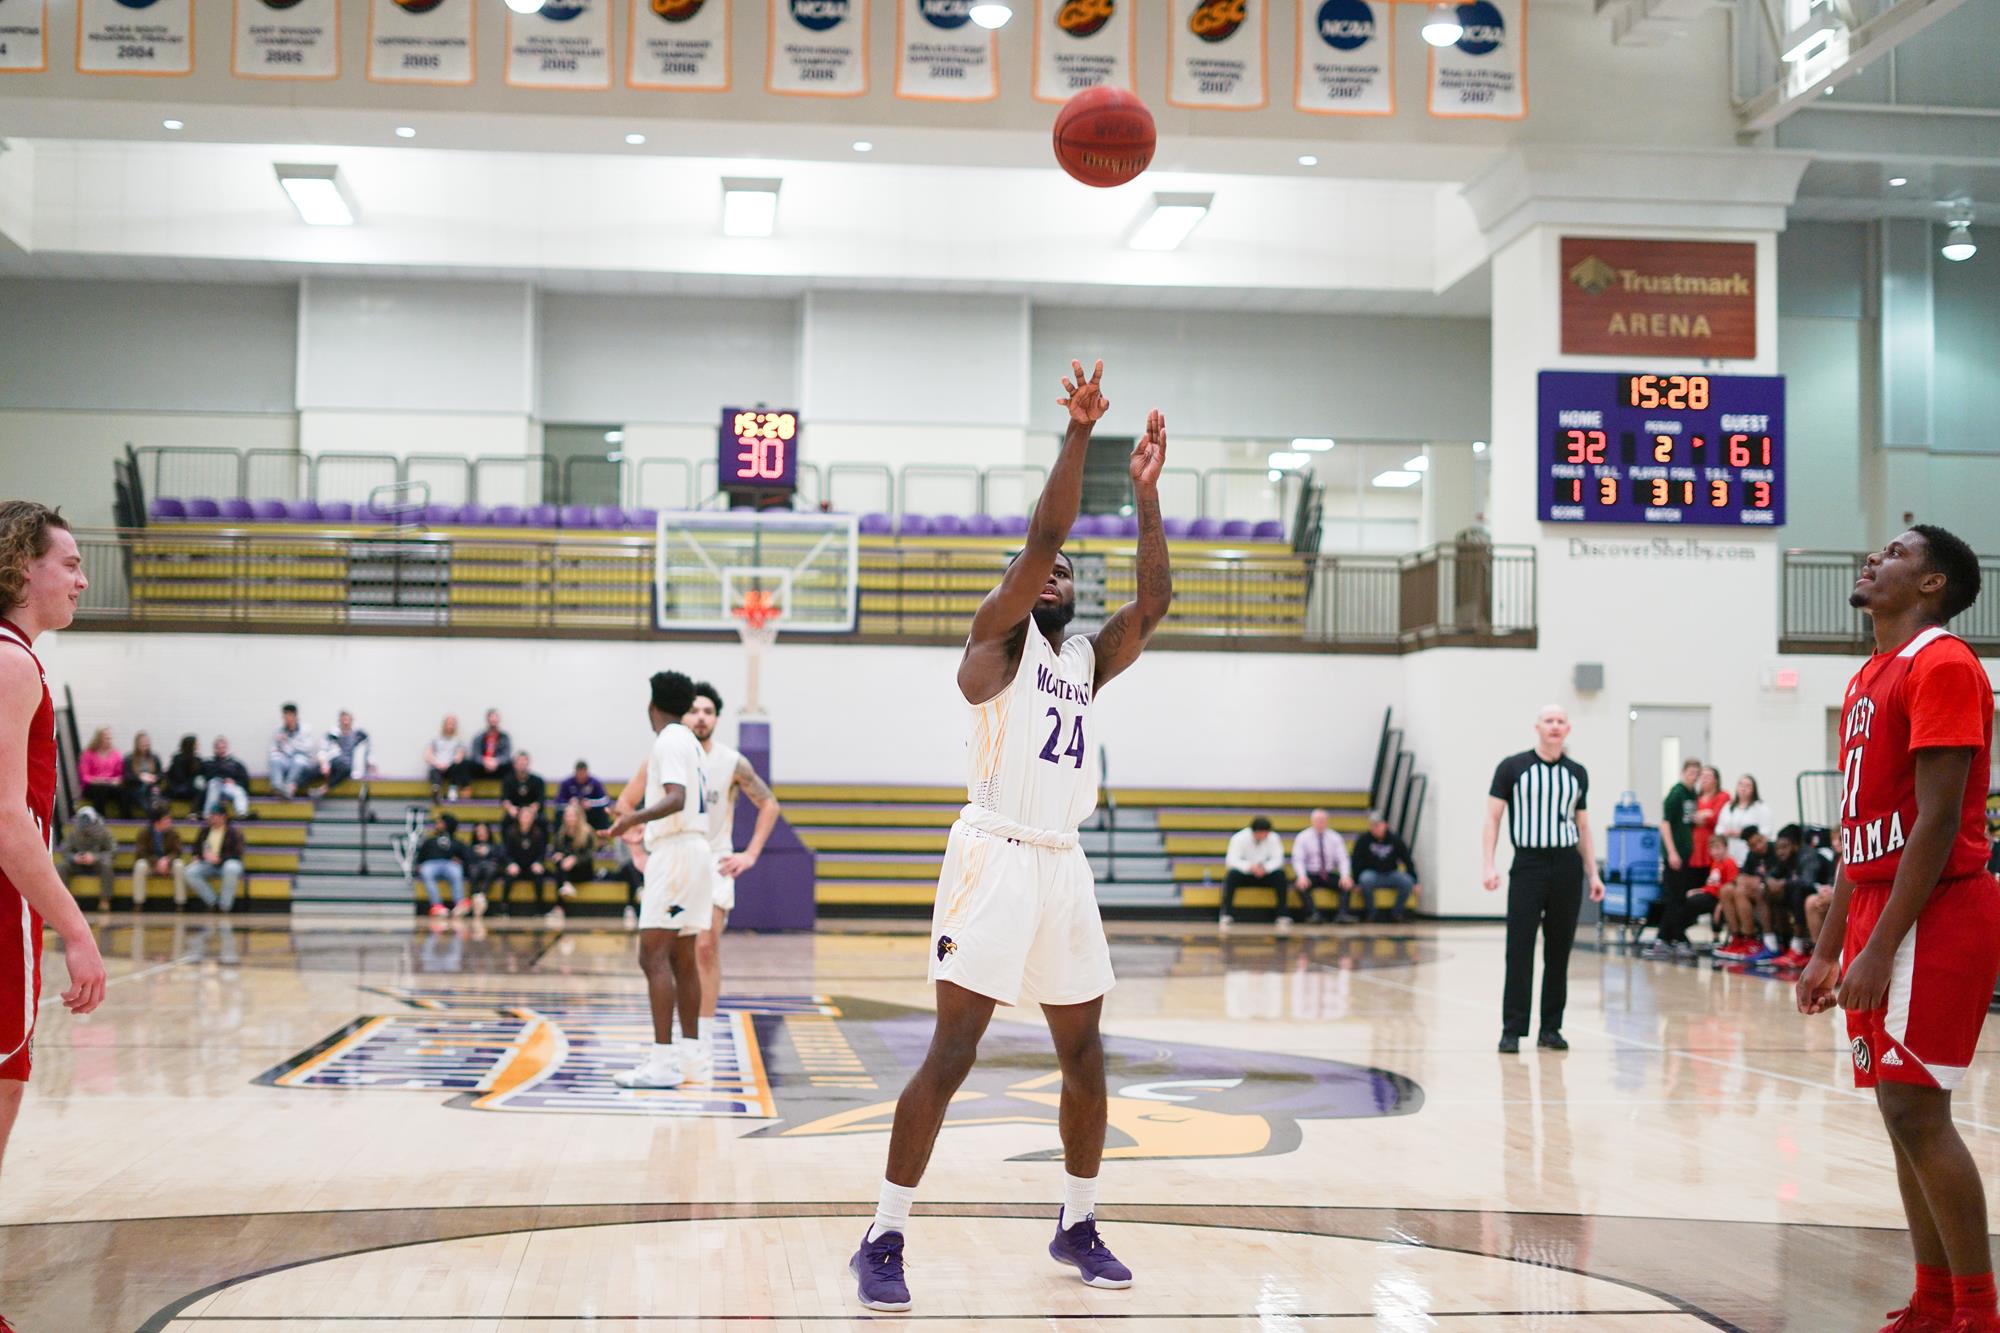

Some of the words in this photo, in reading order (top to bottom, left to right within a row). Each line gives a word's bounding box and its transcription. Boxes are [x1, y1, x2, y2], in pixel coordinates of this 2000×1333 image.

[117, 45, 155, 60] 2004
[1617, 269, 1749, 296] Trustmark
[1607, 312, 1713, 339] ARENA
[1631, 375, 1709, 410] 15:28
[734, 412, 796, 440] 15:28
[1559, 410, 1603, 429] HOME
[1720, 414, 1770, 432] GUEST
[736, 437, 784, 479] 30
[1567, 430, 1607, 464] 32
[1654, 435, 1673, 463] 2
[1729, 434, 1771, 467] 61
[1572, 478, 1581, 503] 1
[1600, 477, 1617, 505] 3
[1711, 479, 1728, 507] 3
[1754, 481, 1770, 508] 3
[1568, 537, 1757, 561] DiscoverShelby.com
[1845, 696, 1875, 747] WEST
[1038, 706, 1085, 769] 24
[1841, 810, 1905, 866] BAMA
